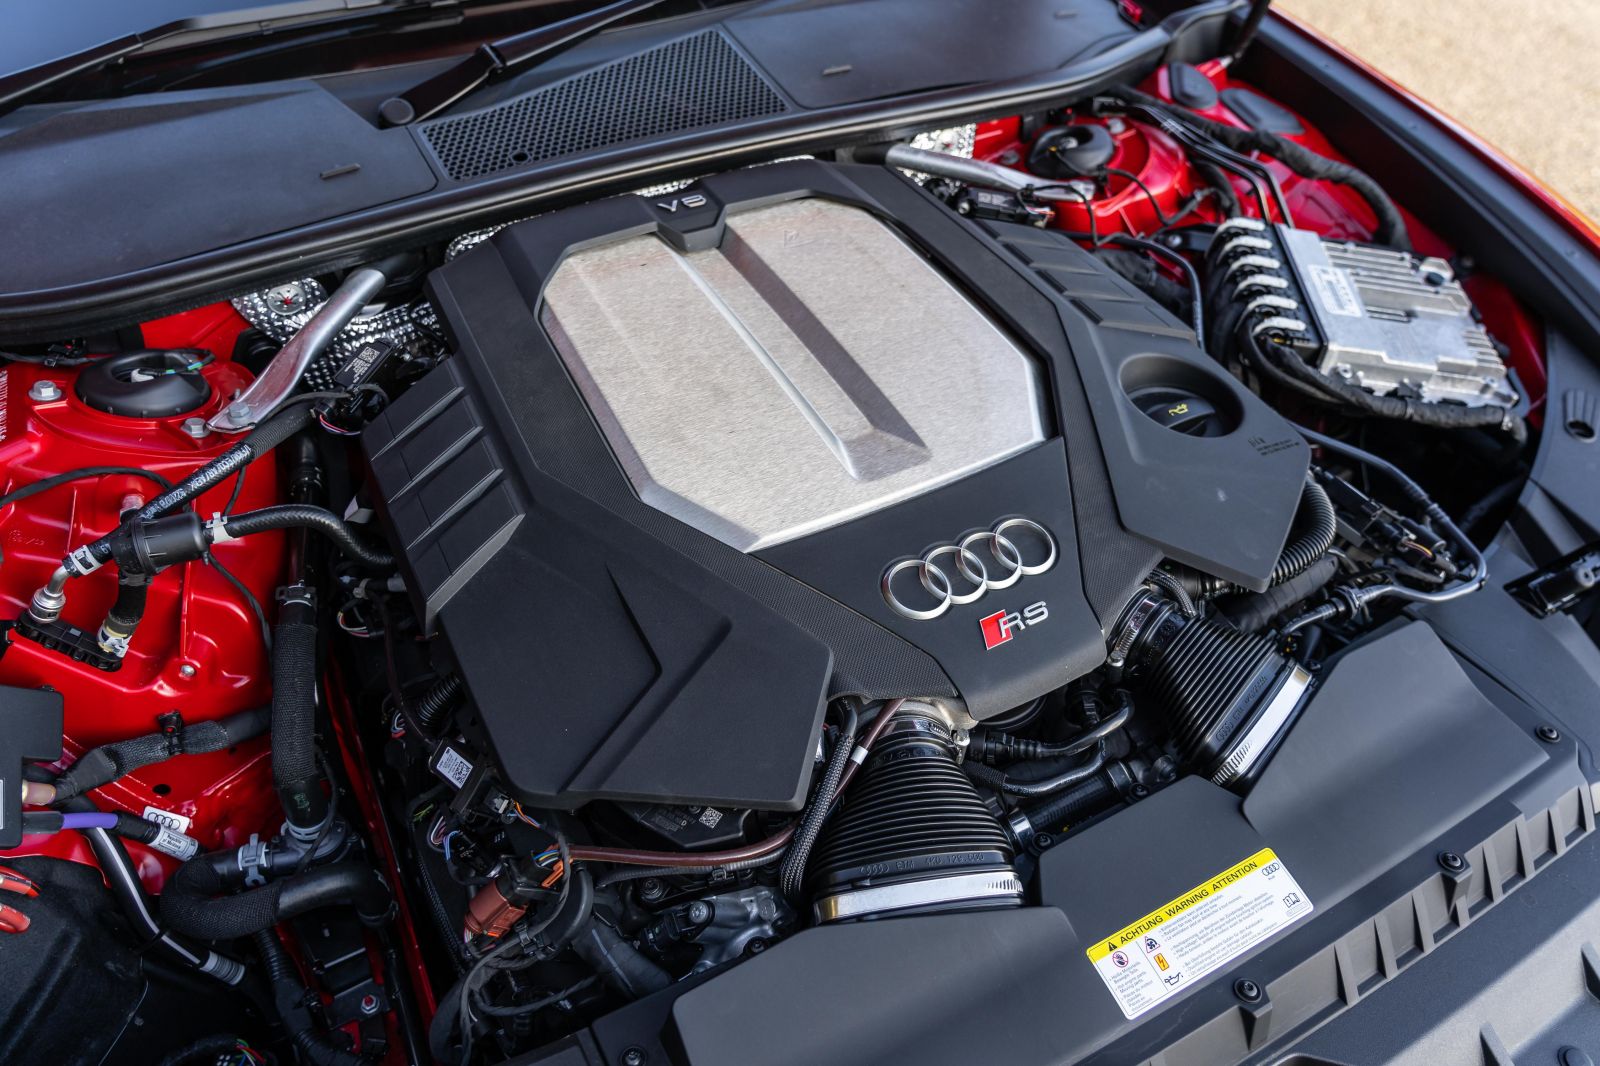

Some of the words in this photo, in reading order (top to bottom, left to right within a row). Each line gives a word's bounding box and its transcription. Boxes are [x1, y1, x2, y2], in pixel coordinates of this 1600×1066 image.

[657, 194, 707, 212] V8
[998, 600, 1049, 639] RS
[1120, 915, 1163, 944] ACHTUNG
[1165, 889, 1209, 917] WARNING
[1212, 861, 1258, 892] ATTENTION
